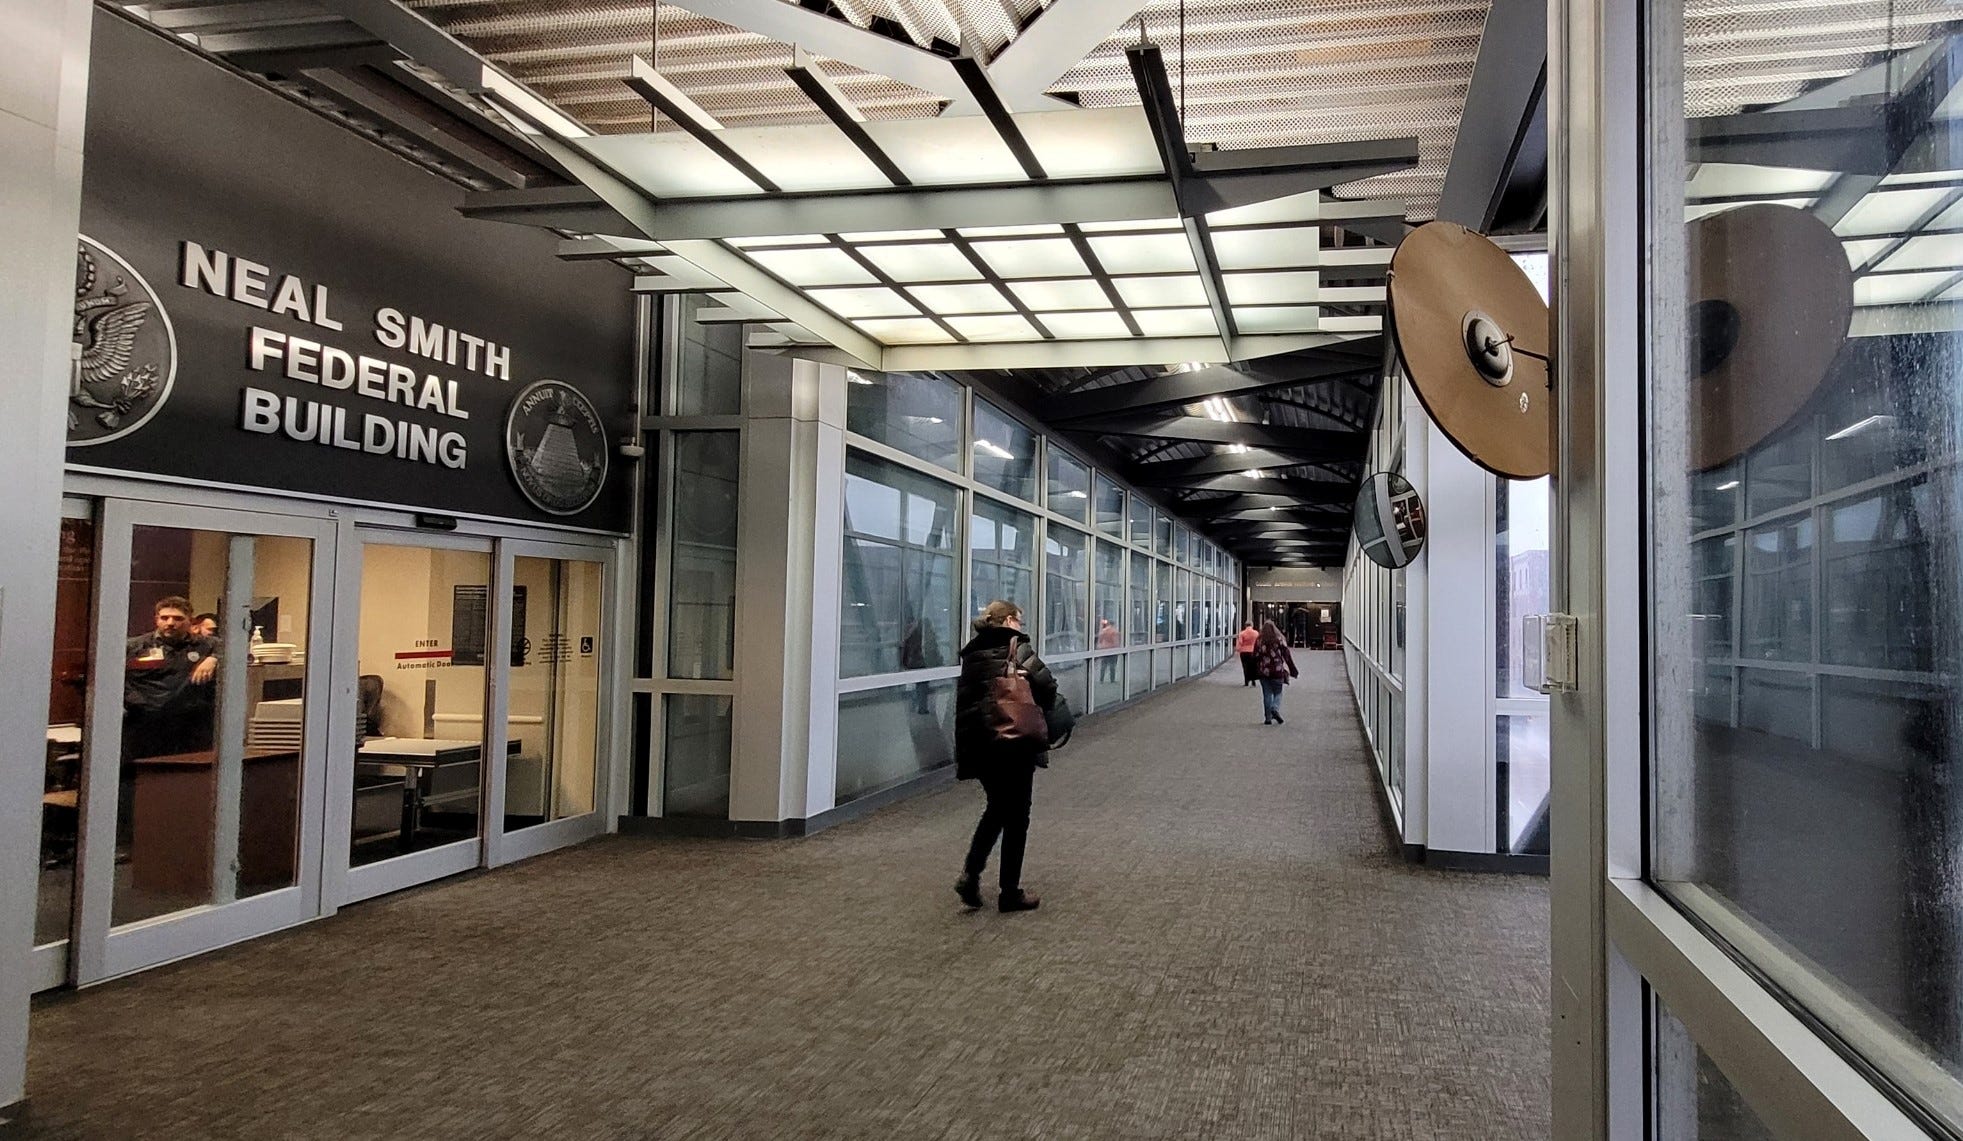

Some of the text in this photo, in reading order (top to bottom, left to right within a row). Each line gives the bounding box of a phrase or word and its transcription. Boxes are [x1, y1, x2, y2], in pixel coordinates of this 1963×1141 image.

[180, 240, 511, 381] NEAL SMITH
[249, 325, 470, 420] FEDERAL
[241, 386, 467, 470] BUILDING
[521, 388, 554, 416] ANNUIT
[397, 661, 436, 670] Automatic
[415, 639, 439, 648] ENTER
